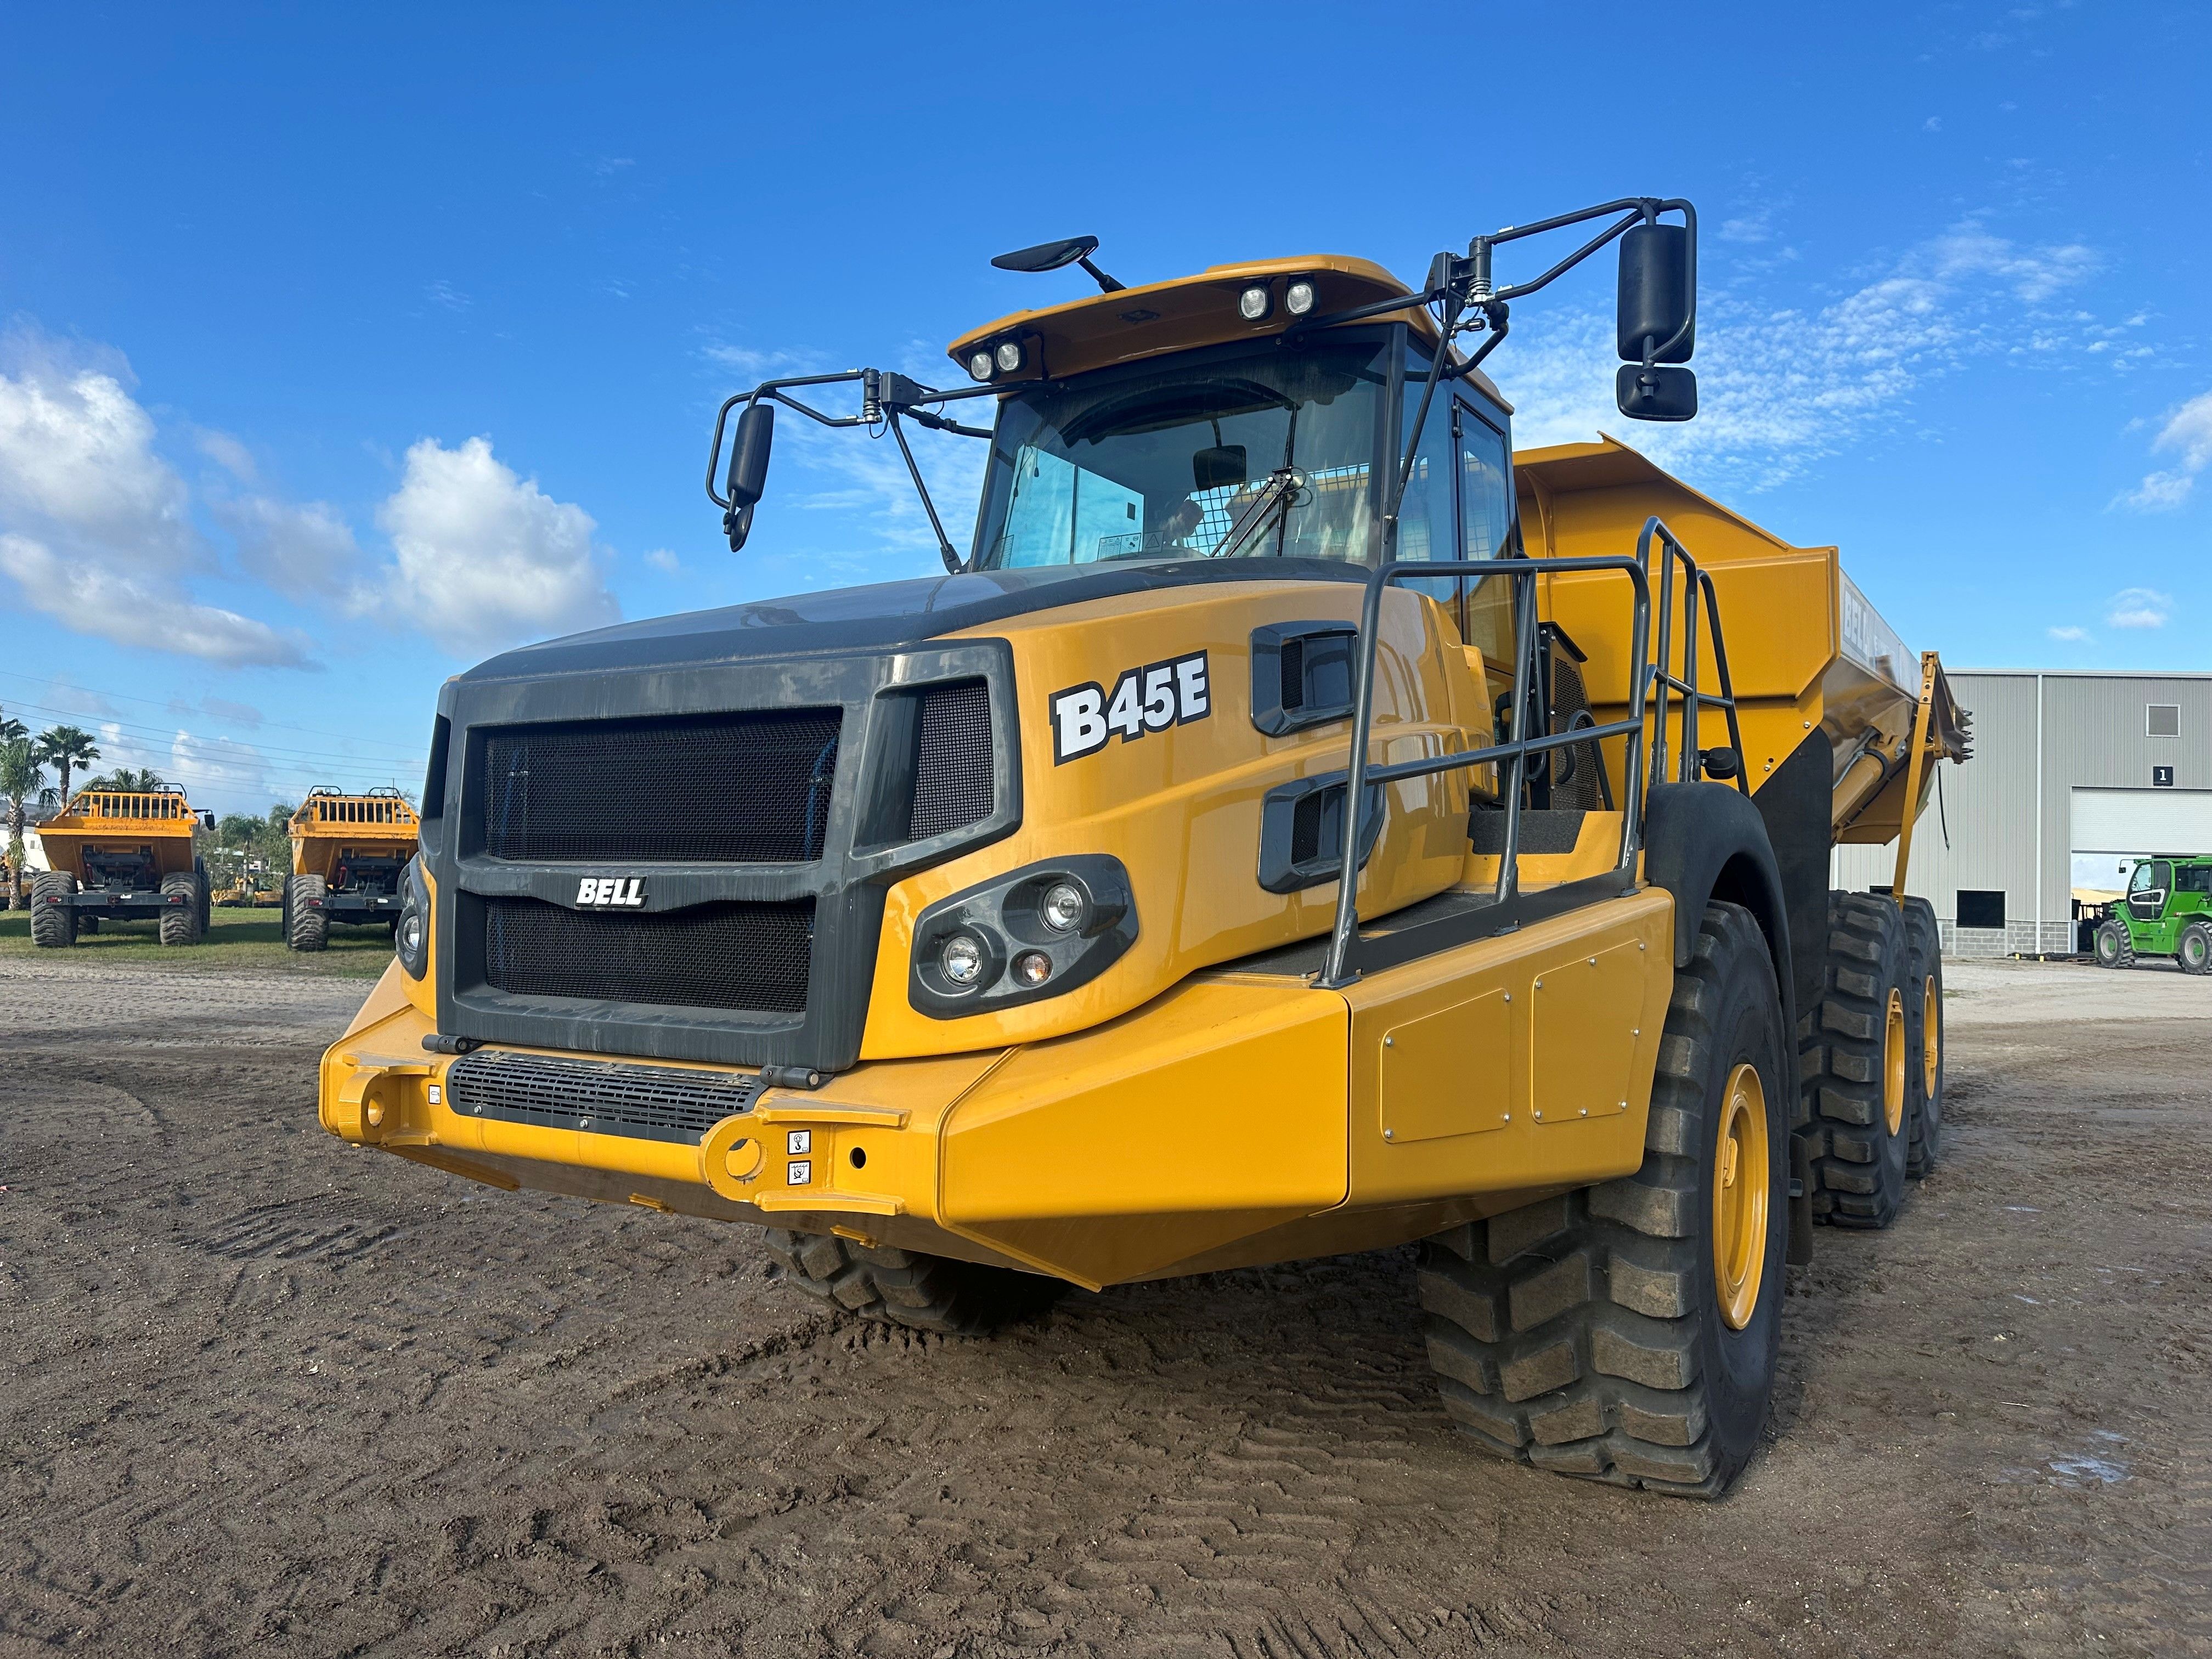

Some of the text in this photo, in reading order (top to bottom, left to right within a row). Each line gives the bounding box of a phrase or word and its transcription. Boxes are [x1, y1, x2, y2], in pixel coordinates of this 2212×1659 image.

[1056, 657, 1207, 758] B45E
[2160, 769, 2166, 781] 1
[576, 878, 642, 905] BELL
